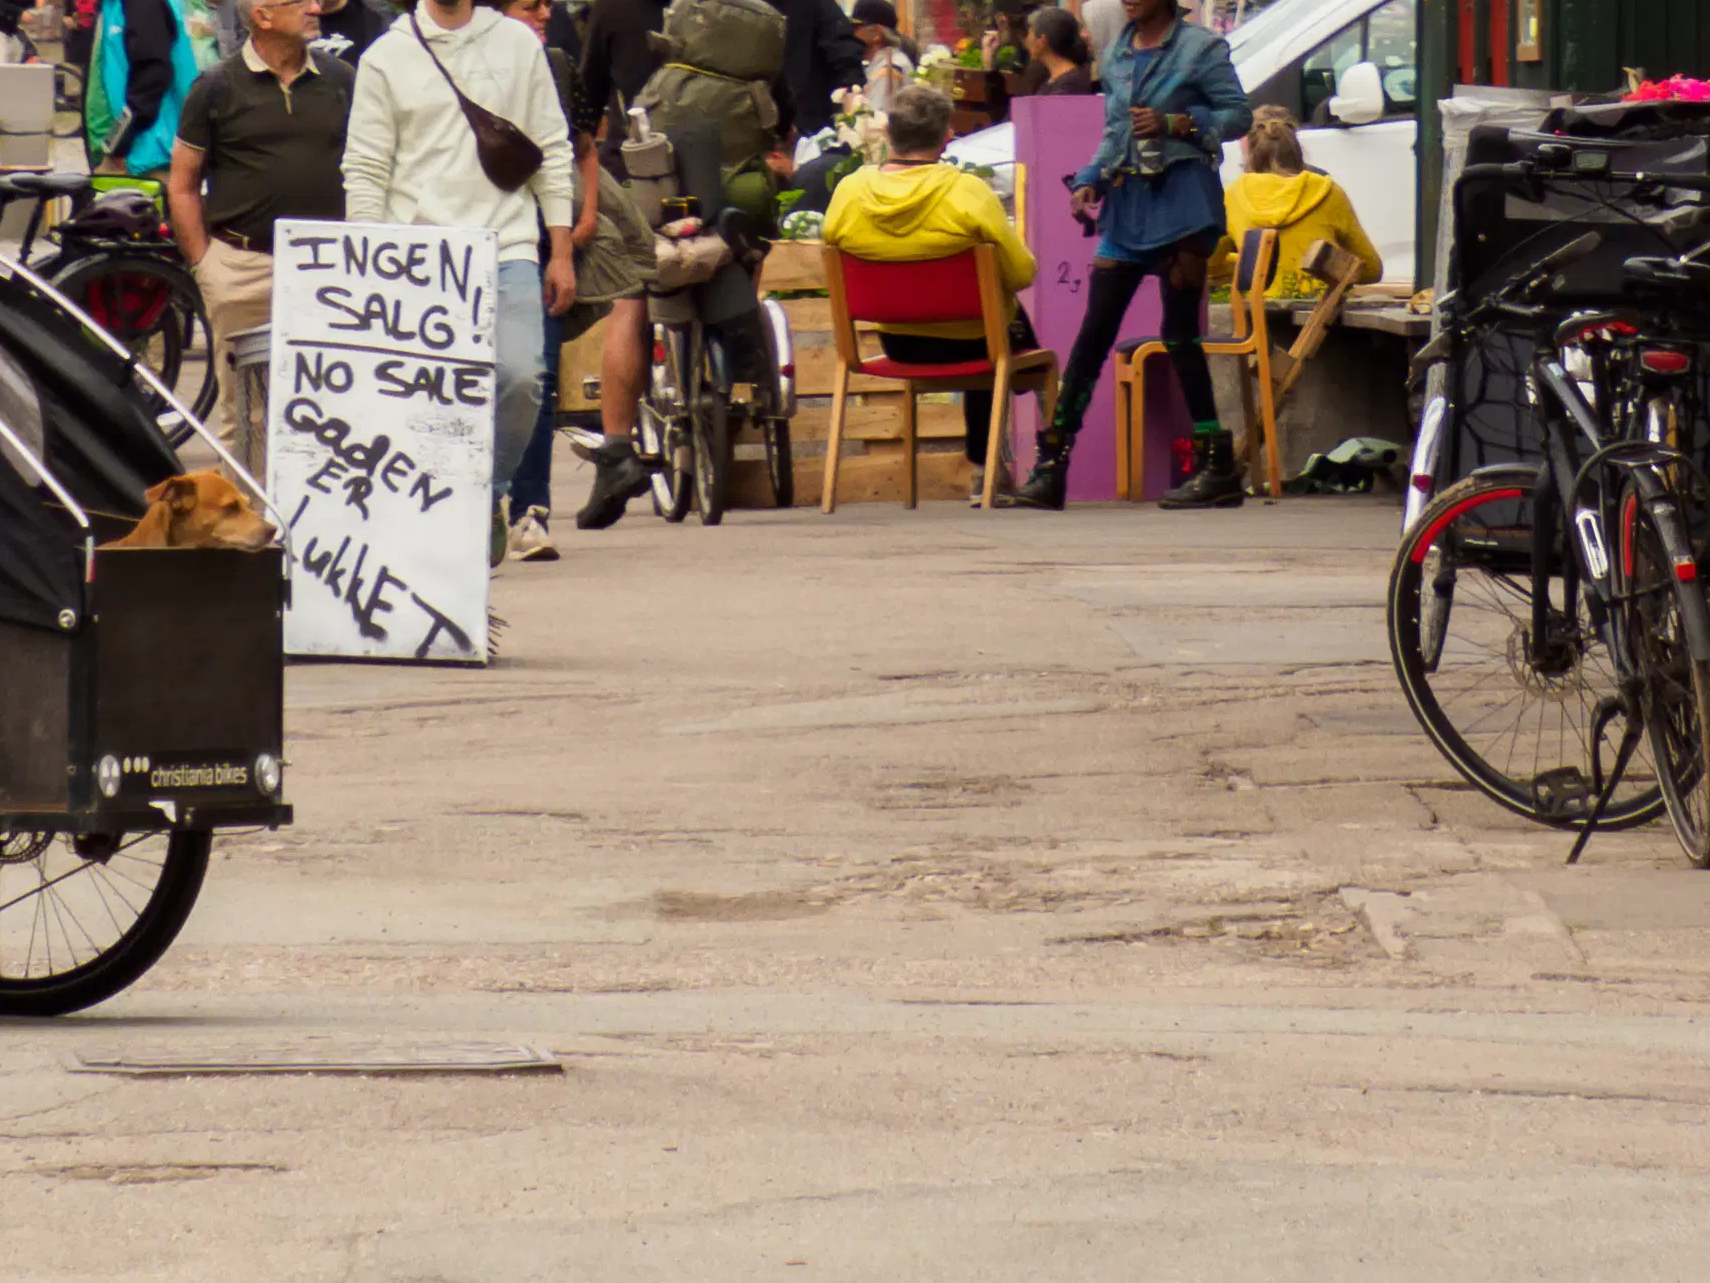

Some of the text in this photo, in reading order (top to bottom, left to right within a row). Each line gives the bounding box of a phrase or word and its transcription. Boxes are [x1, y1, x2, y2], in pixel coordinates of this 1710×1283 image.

[289, 235, 473, 302] INGEN
[294, 351, 490, 406] NO SALE
[306, 457, 374, 521] ER
[150, 762, 249, 788] christiania bikes
